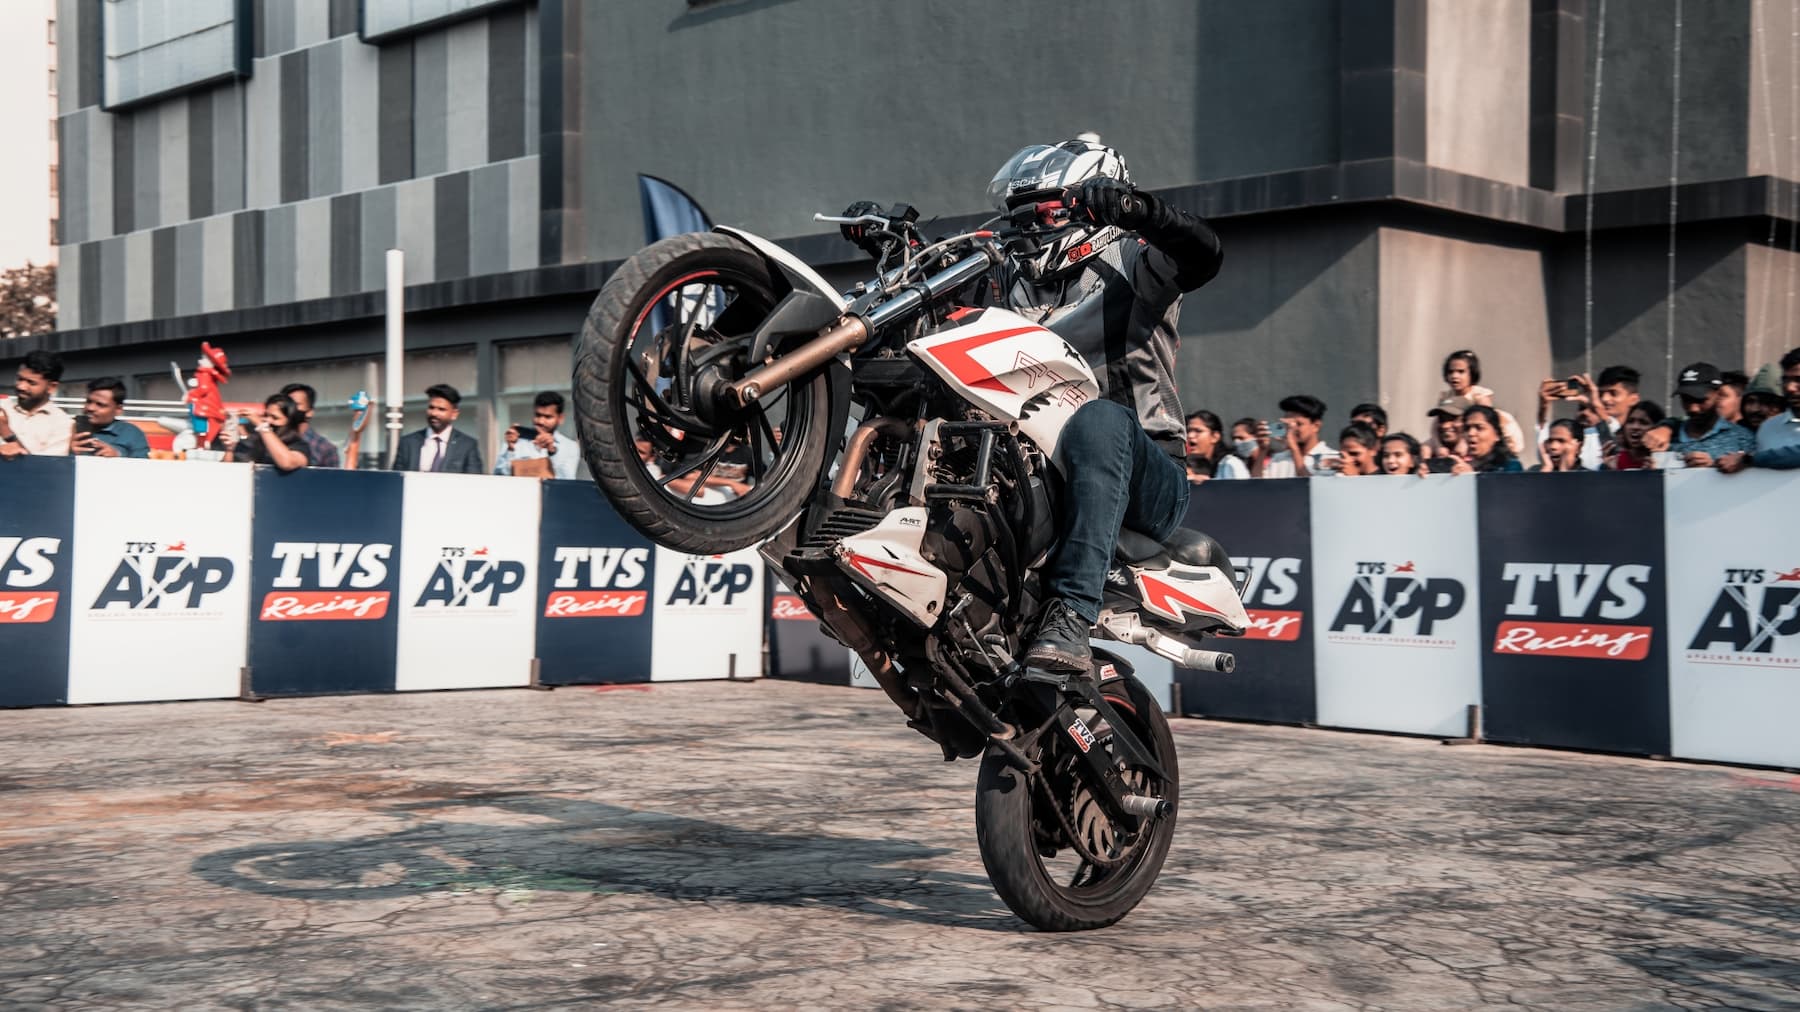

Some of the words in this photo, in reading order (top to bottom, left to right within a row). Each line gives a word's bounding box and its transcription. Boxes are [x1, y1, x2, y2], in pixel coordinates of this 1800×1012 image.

[126, 542, 156, 553] TVS
[272, 542, 393, 588] TVS
[442, 547, 465, 557] TVS
[554, 547, 649, 588] TVS
[1356, 561, 1386, 575] TVS
[90, 556, 234, 609] APP
[413, 559, 525, 607] APP
[665, 562, 753, 606] APP
[1228, 557, 1302, 606] VS
[1502, 562, 1652, 620] TVS
[1725, 569, 1765, 584] TVS
[263, 595, 387, 618] Racing
[546, 594, 645, 615] Racing
[1328, 576, 1465, 636] APP
[1687, 585, 1800, 653] AP
[1497, 627, 1648, 656] Racing
[1075, 720, 1094, 744] TVS
